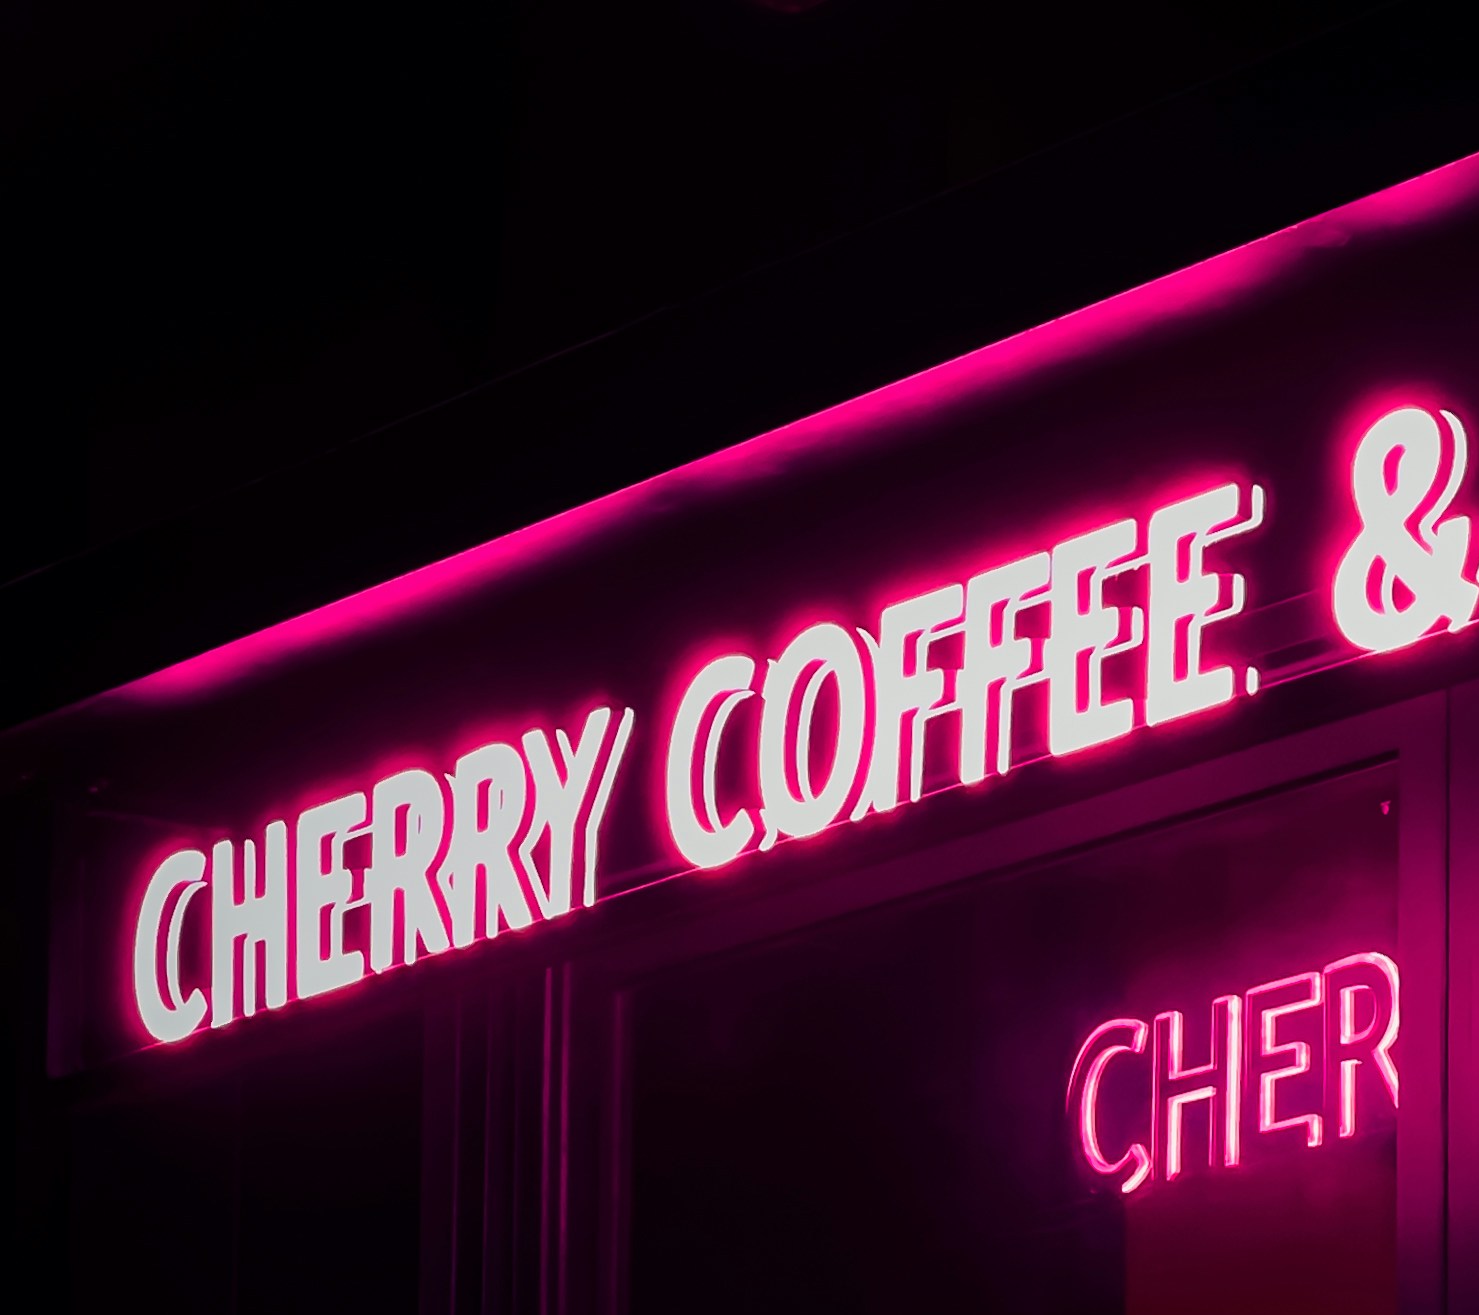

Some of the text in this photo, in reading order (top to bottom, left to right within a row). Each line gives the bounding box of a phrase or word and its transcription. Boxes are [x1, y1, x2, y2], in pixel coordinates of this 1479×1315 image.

[133, 706, 635, 1045] CHERRY
[664, 482, 1265, 871] COFFEE
[1065, 947, 1400, 1194] CHER
